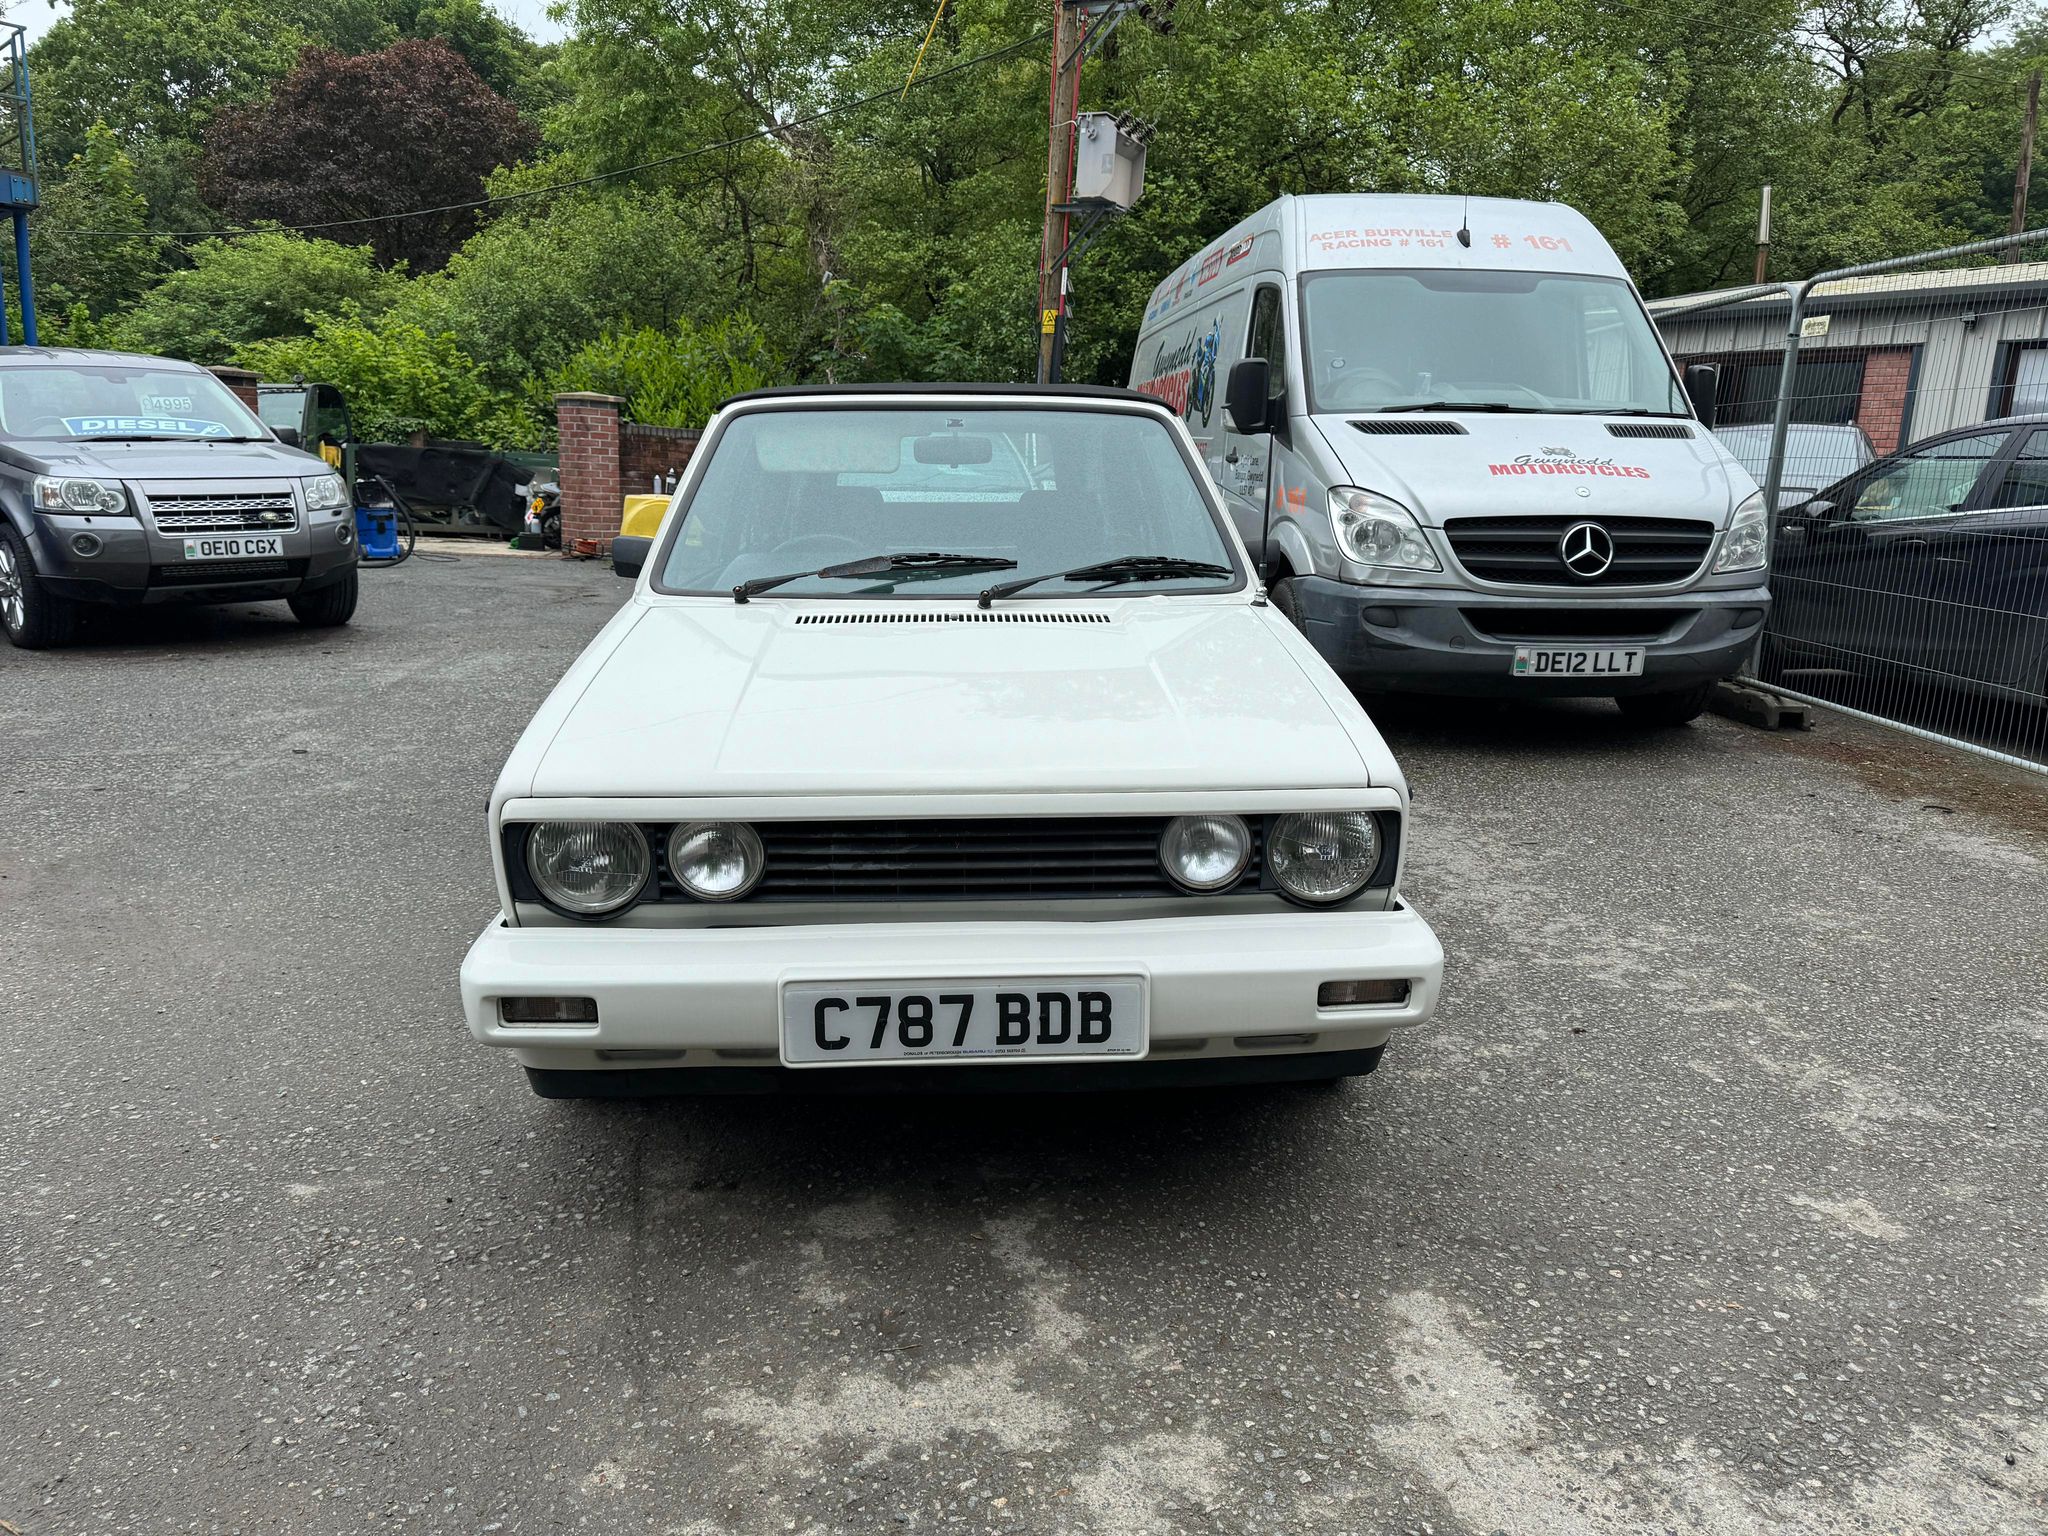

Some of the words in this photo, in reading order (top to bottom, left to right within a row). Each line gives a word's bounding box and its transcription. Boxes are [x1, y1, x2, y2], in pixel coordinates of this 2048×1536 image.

[1310, 230, 1357, 242] ACER
[1364, 228, 1453, 239] BURVILLE
[1490, 233, 1512, 249] #
[1523, 234, 1574, 252] 161
[1321, 238, 1392, 251] RACING
[1399, 238, 1410, 247] #
[1417, 238, 1445, 248] 161
[82, 419, 195, 432] DIESEL
[1514, 454, 1614, 467] Gwynedd
[1488, 463, 1651, 479] MOTORCYCLES
[201, 540, 240, 556] OE10
[245, 539, 277, 554] CGX
[1535, 652, 1587, 673] DE12
[1593, 652, 1637, 672] LLT
[814, 994, 974, 1051] C787
[995, 991, 1112, 1046] BDB
